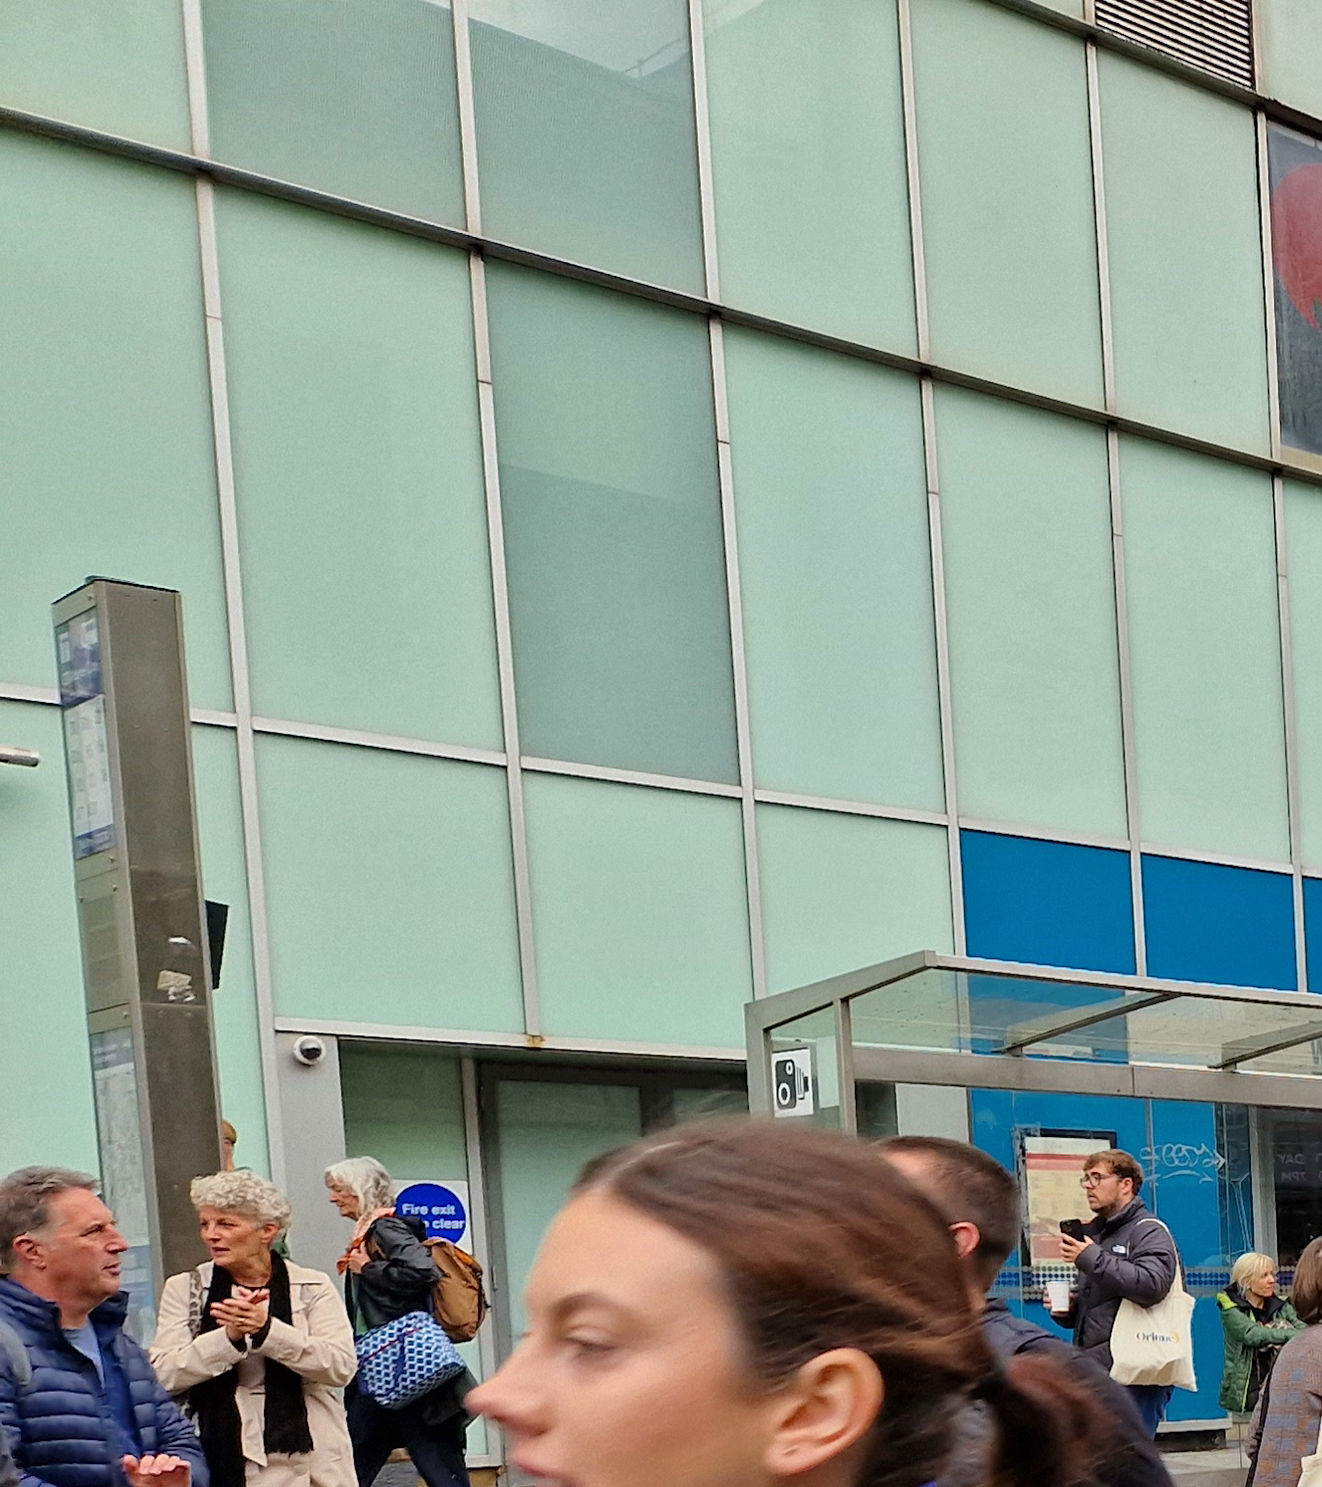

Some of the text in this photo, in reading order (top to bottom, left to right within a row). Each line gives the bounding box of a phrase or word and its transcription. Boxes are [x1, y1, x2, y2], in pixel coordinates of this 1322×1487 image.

[402, 1203, 456, 1215] Fire exit
[432, 1218, 464, 1229] clear
